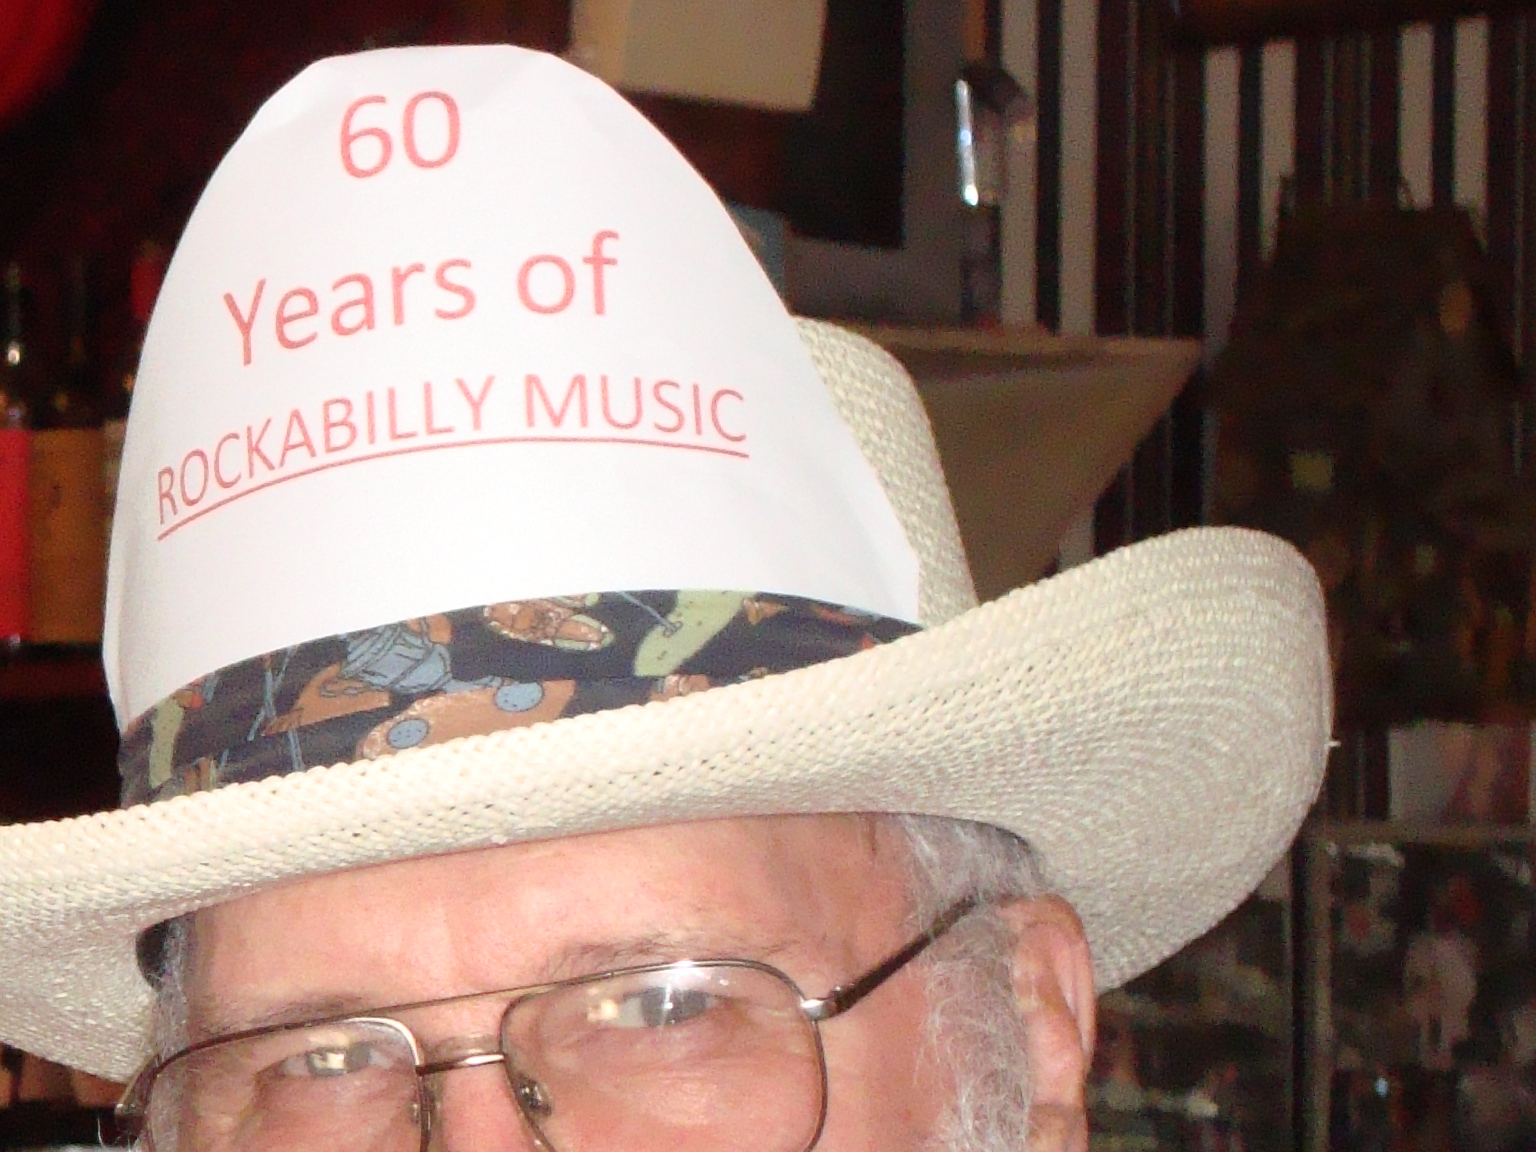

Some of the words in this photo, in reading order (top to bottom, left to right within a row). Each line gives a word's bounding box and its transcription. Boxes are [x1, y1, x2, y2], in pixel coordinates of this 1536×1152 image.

[338, 88, 462, 180] 60
[220, 257, 477, 369] Years
[515, 228, 621, 317] of
[155, 373, 496, 527] ROCKABILLY
[524, 373, 748, 446] MUSIC
